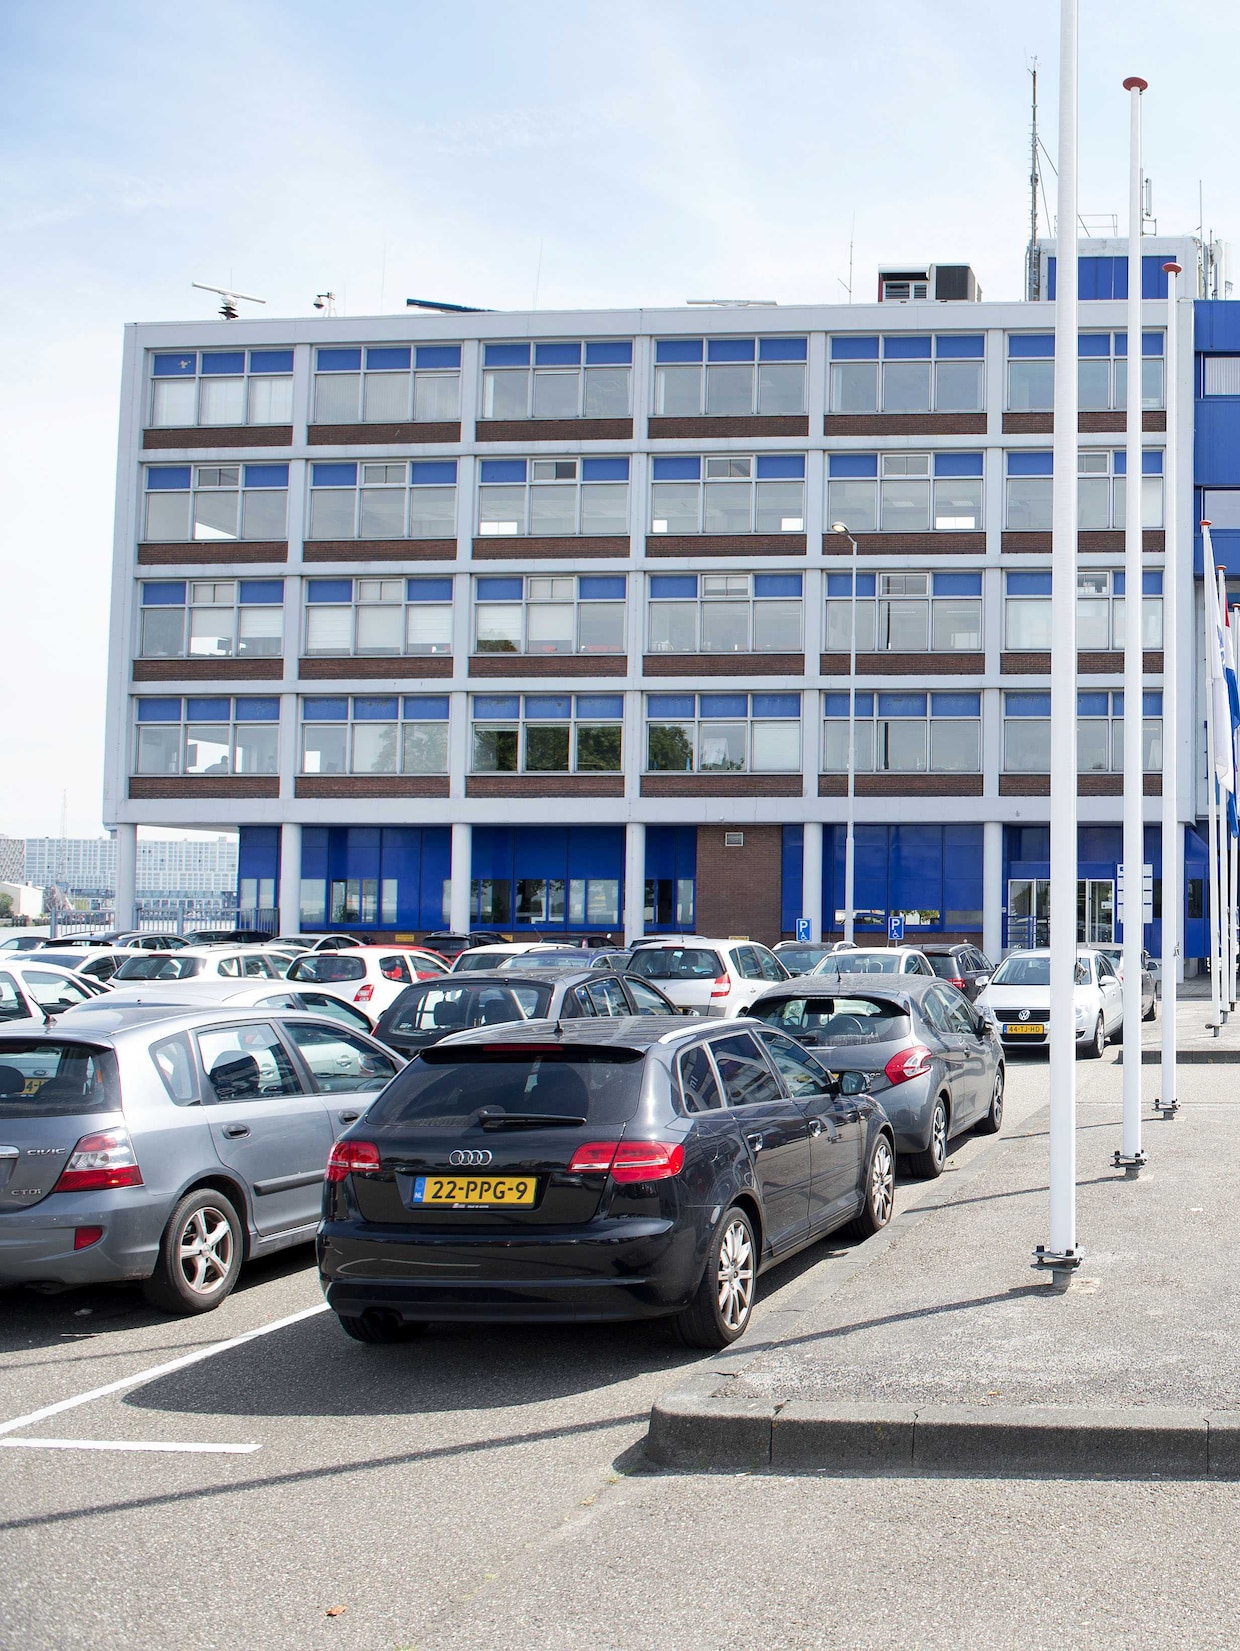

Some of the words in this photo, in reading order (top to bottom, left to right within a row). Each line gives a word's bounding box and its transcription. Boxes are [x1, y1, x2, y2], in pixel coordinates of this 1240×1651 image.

[799, 920, 808, 932] P
[891, 918, 900, 931] P
[27, 1148, 67, 1156] CIVIC
[432, 1180, 528, 1200] 22-PPG-9
